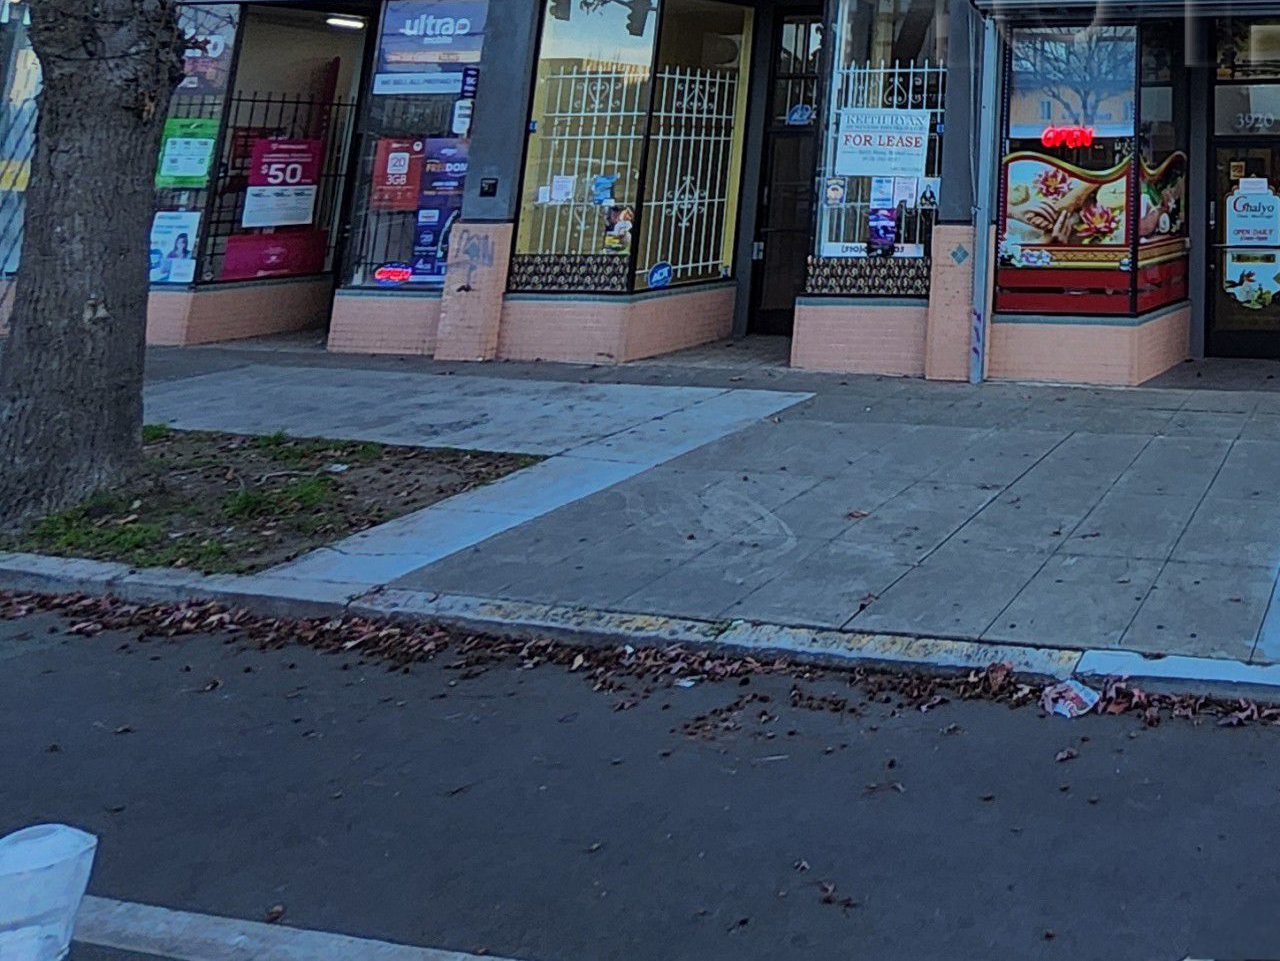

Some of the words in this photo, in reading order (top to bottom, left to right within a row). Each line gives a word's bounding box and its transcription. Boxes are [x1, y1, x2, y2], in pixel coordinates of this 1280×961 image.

[402, 14, 455, 36] ultra
[1234, 112, 1275, 128] 3920
[844, 134, 873, 147] FOR
[878, 136, 923, 148] LEASE
[260, 163, 302, 185] $50
[386, 174, 407, 186] 3GB
